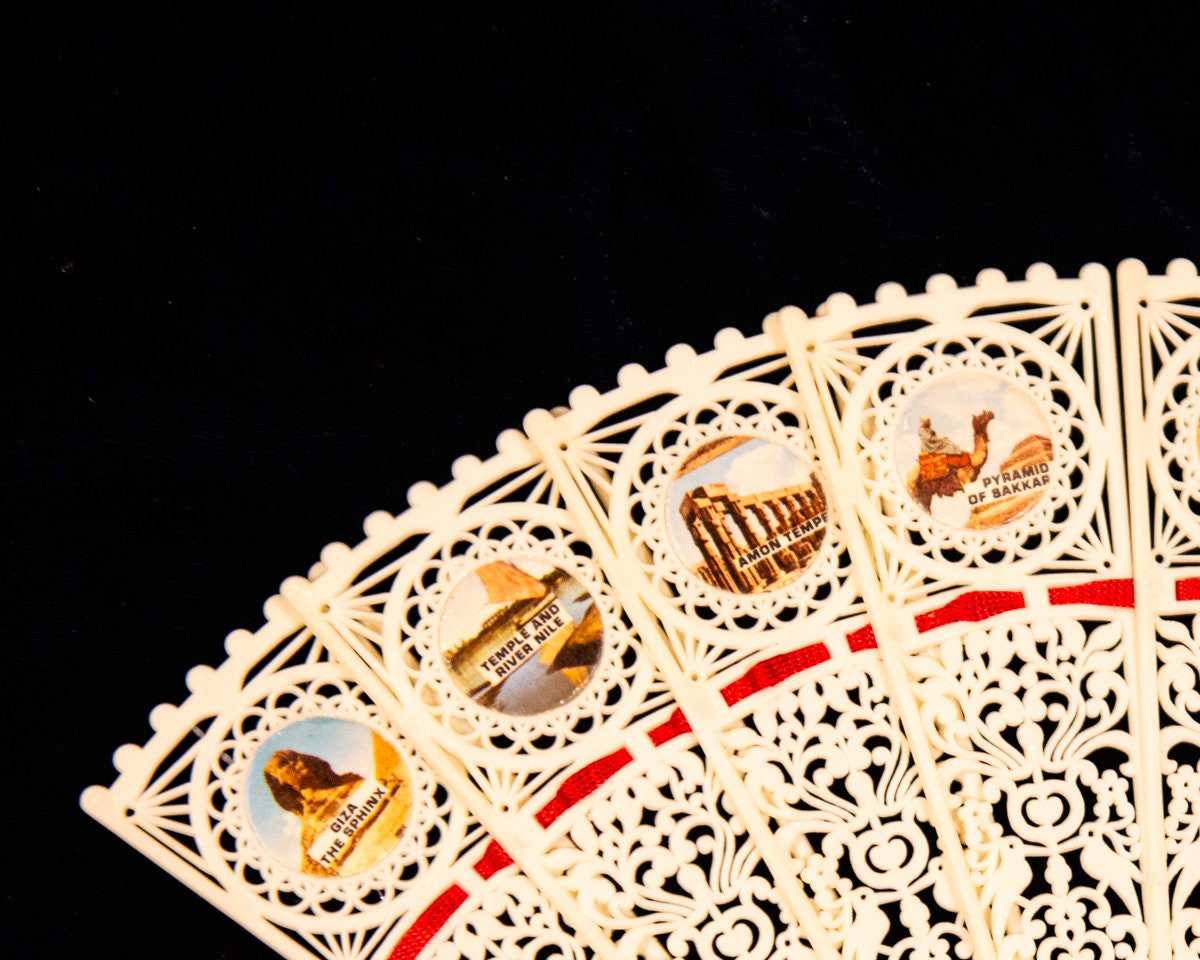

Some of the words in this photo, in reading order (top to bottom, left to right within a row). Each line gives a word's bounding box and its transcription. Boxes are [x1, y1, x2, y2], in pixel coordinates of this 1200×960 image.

[982, 463, 1049, 488] PYRAMID
[968, 491, 986, 505] OF
[738, 539, 781, 568] AMON
[480, 628, 531, 672] TEMPLE
[531, 604, 560, 630] AND
[495, 643, 534, 678] RIVER
[533, 616, 565, 645] NILE
[320, 838, 345, 864] THE
[343, 787, 386, 837] SPHINX
[330, 803, 358, 833] GIZA
